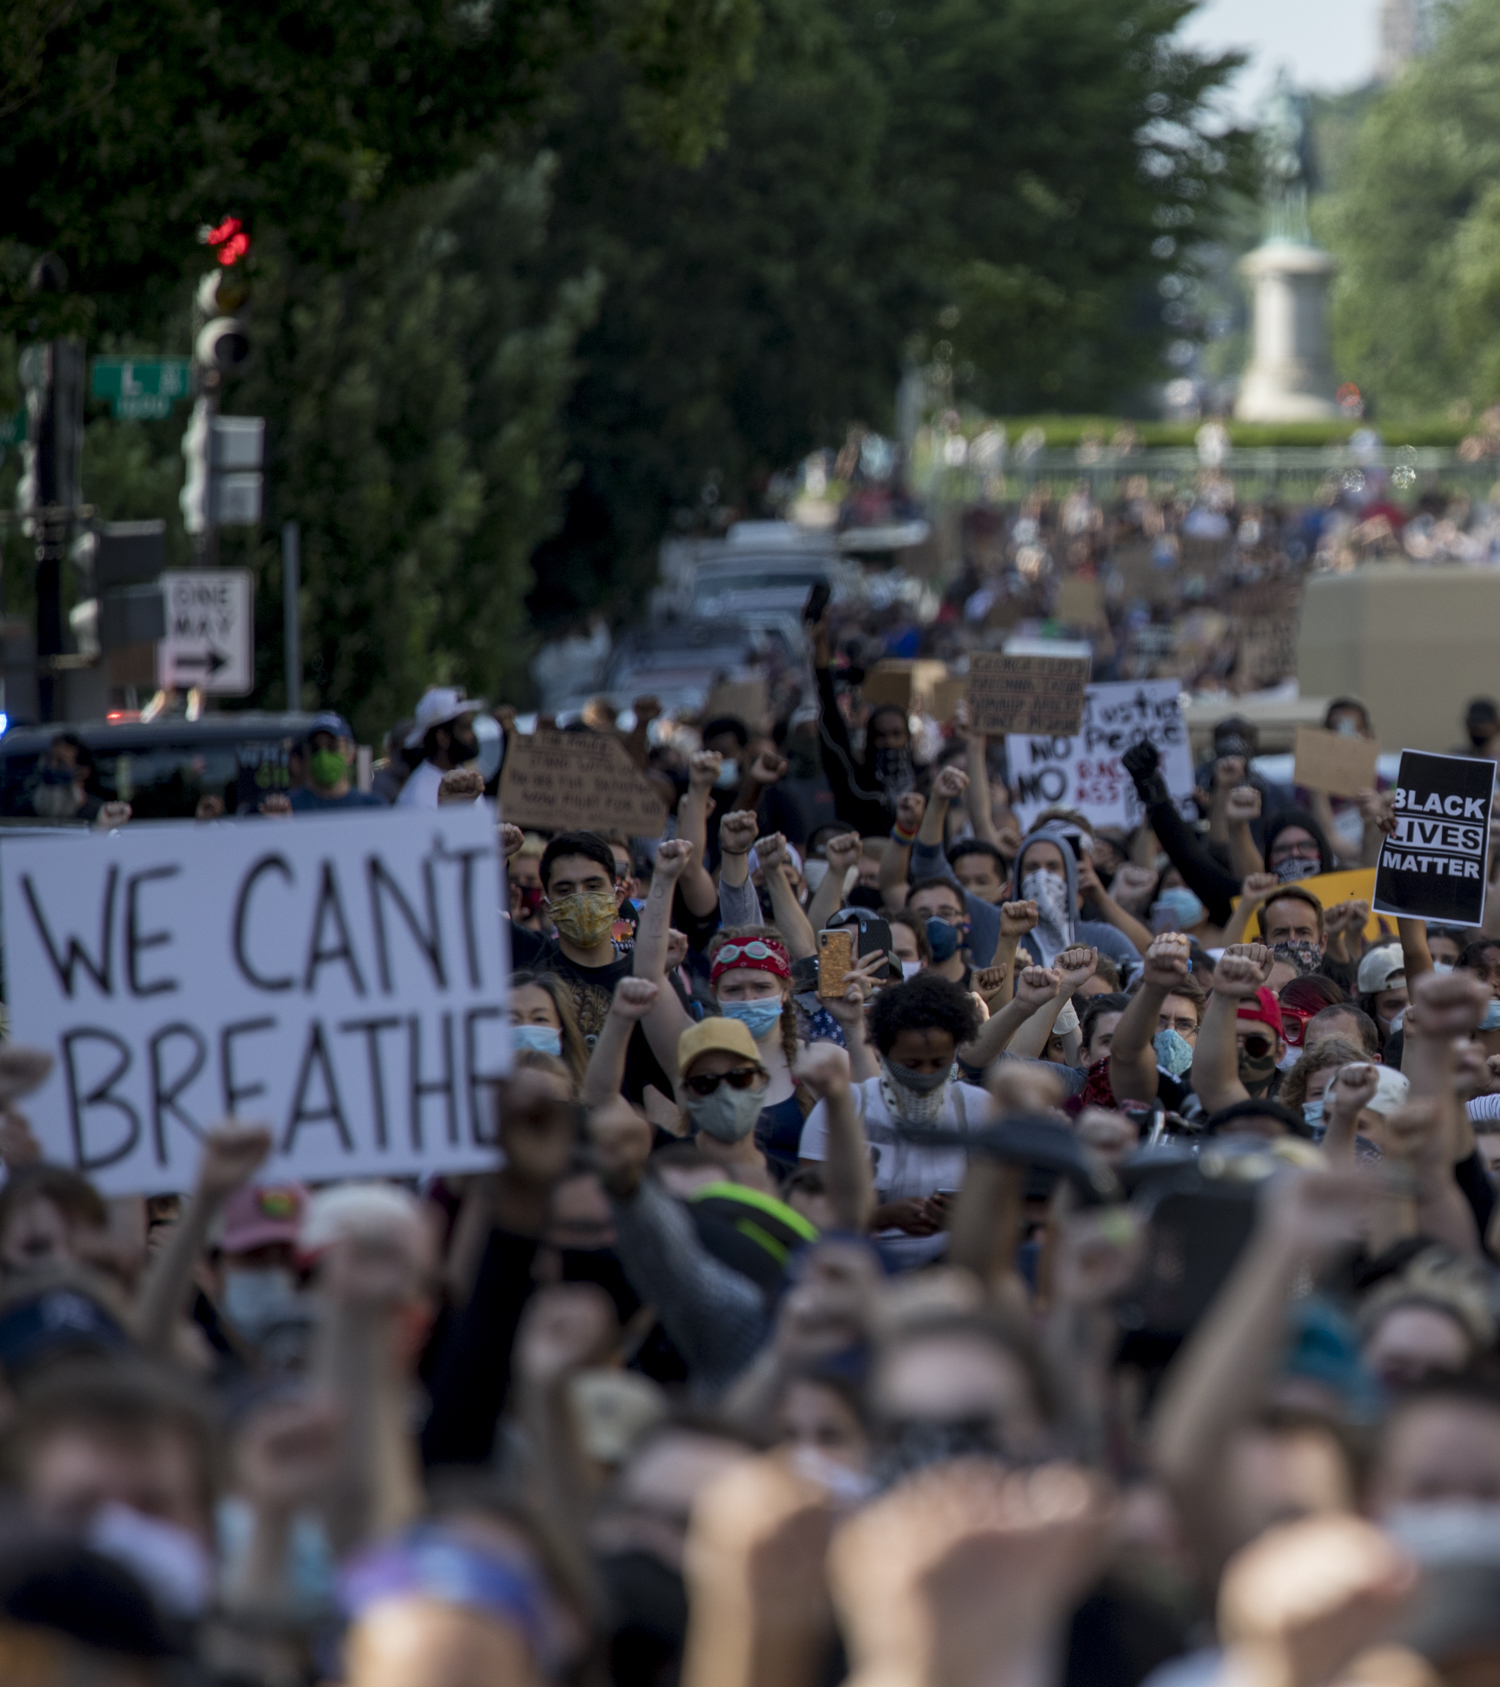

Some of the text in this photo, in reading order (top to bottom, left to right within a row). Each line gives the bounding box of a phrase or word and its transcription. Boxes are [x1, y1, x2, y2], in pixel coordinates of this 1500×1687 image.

[1029, 735, 1072, 763] NO
[1018, 764, 1069, 805] NO
[1394, 787, 1486, 819] BLACK
[1382, 850, 1480, 880] MATTER
[20, 830, 490, 1000] WE CAN'T
[60, 1005, 503, 1172] BREATHE
